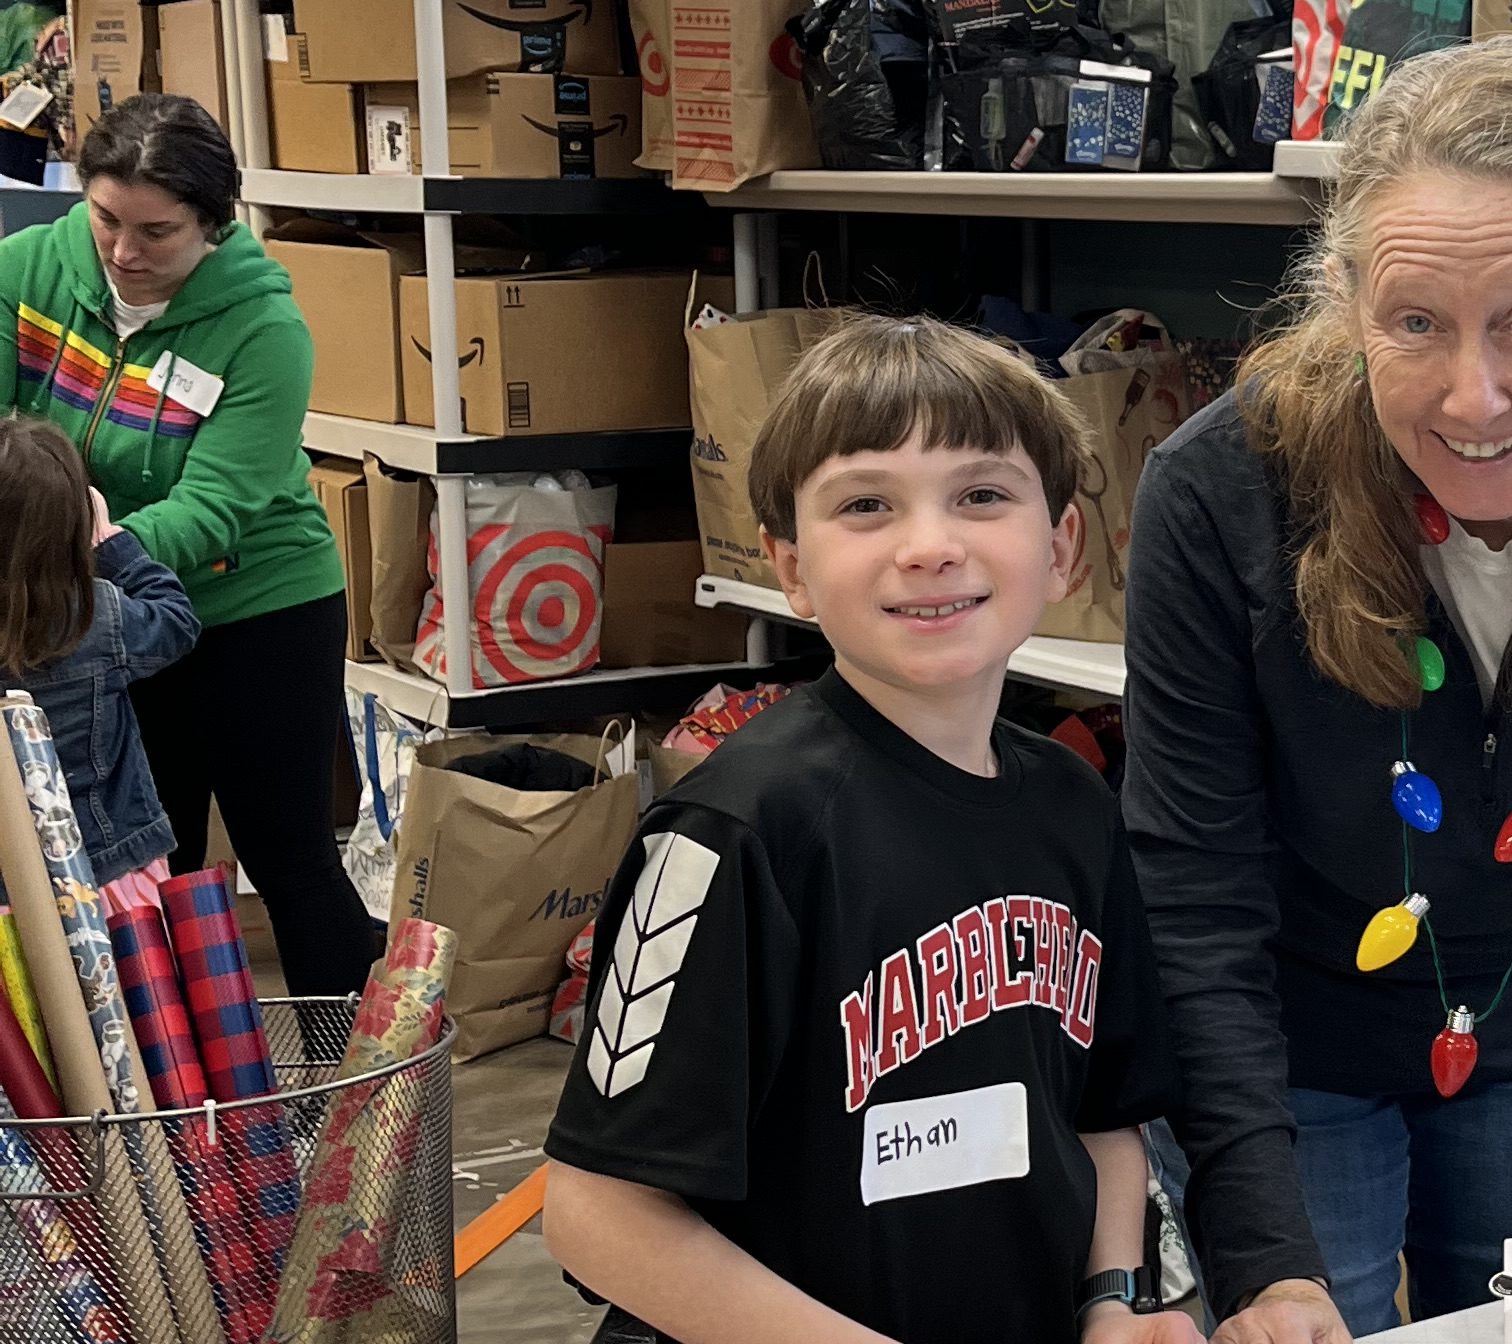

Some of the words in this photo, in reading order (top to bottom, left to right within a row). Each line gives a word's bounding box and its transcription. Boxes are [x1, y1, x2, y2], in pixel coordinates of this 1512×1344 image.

[408, 856, 430, 918] shalls
[839, 894, 1103, 1114] MARBLEHED
[875, 1116, 958, 1166] Ethan
